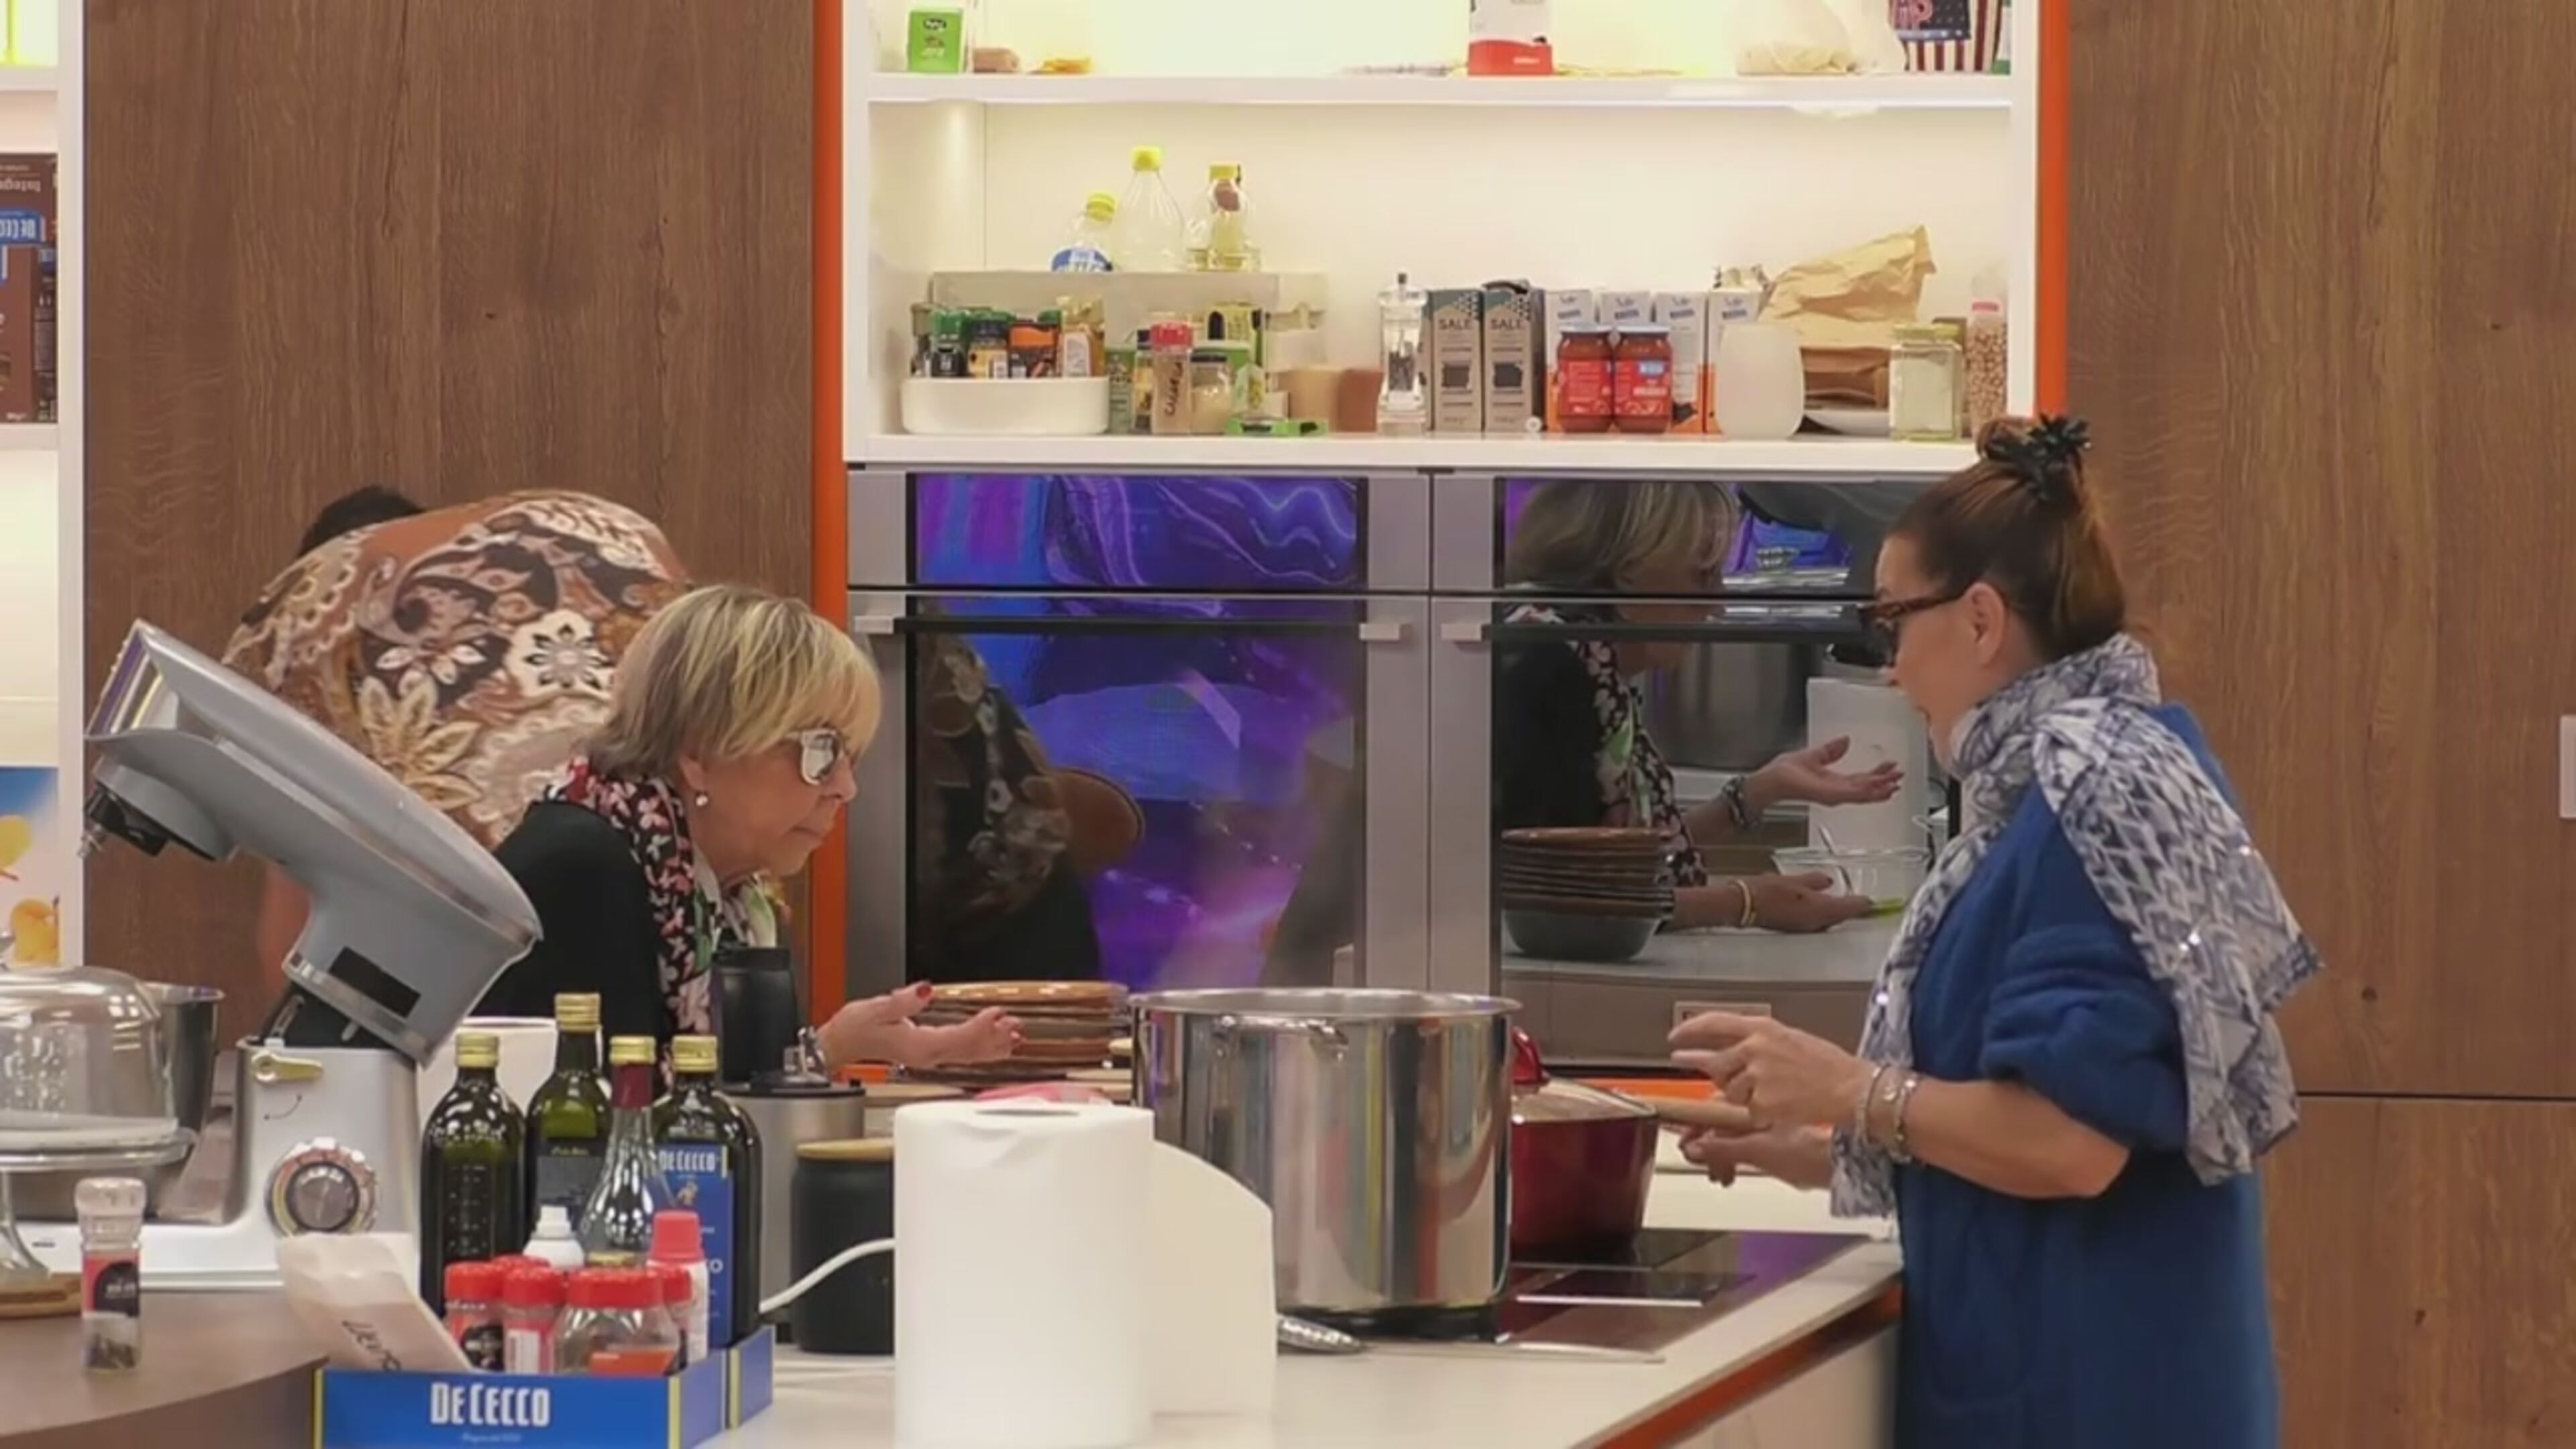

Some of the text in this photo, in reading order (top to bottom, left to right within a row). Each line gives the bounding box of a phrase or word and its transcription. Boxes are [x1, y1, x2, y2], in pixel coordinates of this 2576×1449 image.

[1440, 319, 1472, 330] SALE
[676, 1150, 716, 1172] CECCO
[430, 1382, 550, 1428] DE CECCO
